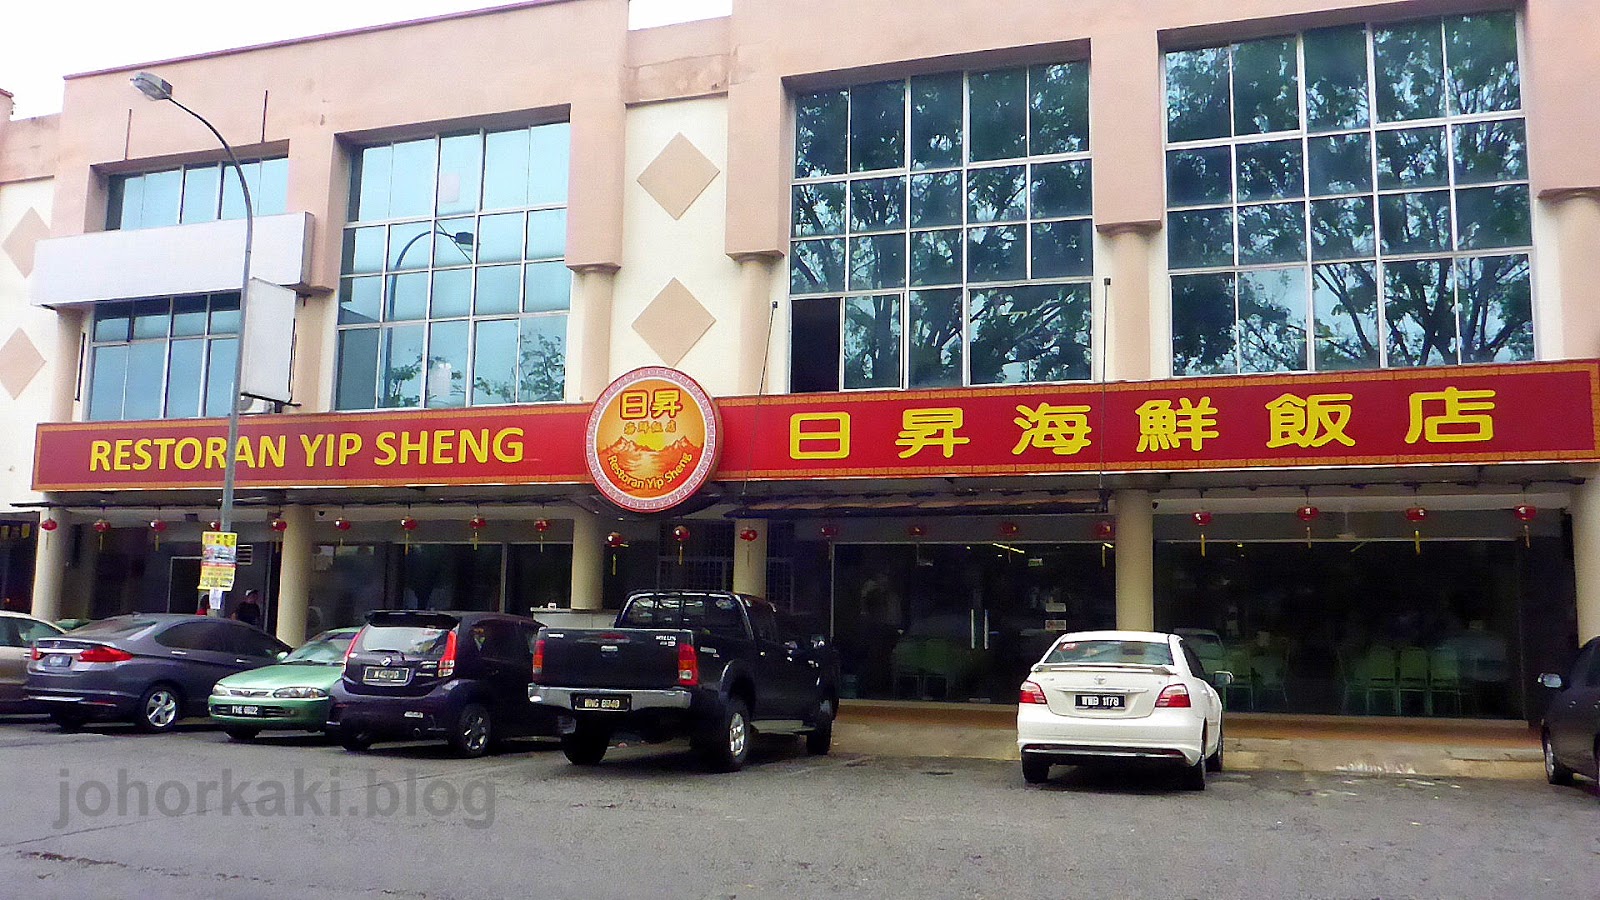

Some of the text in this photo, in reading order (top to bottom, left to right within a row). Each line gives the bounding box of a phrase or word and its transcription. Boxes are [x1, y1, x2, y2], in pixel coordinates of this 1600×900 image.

[620, 389, 683, 419] 日昇
[788, 386, 1496, 461] 日昇海鮮飯店
[89, 427, 524, 472] RESTORAN YIP SHENG
[608, 452, 693, 490] Restoran Yip Sheng
